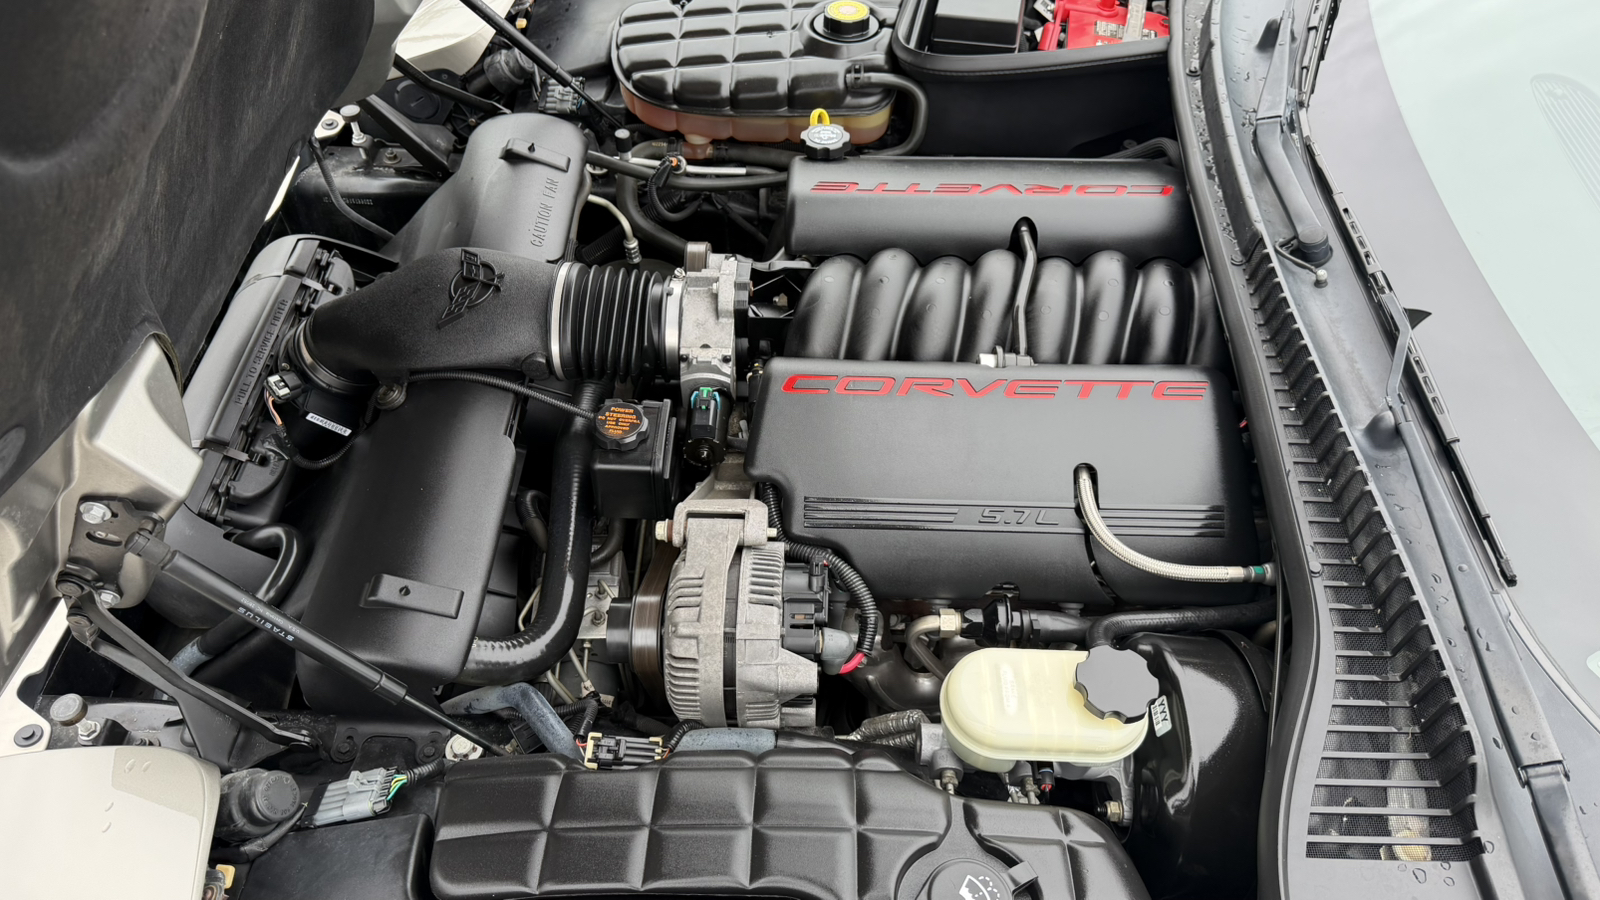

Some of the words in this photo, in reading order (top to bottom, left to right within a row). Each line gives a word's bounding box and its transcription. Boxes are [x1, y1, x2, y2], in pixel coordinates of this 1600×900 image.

[810, 181, 1175, 197] CORVETTE
[530, 202, 553, 247] CAUTION
[543, 176, 560, 199] FAN
[234, 380, 251, 405] PULL
[246, 367, 257, 380] TO
[253, 331, 275, 366] SERVICE
[270, 299, 288, 327] FILTER
[781, 374, 1210, 400] CORVETTE
[978, 508, 1060, 525] 5.7L
[237, 606, 295, 641] STABILUS
[1158, 698, 1169, 722] YYY
